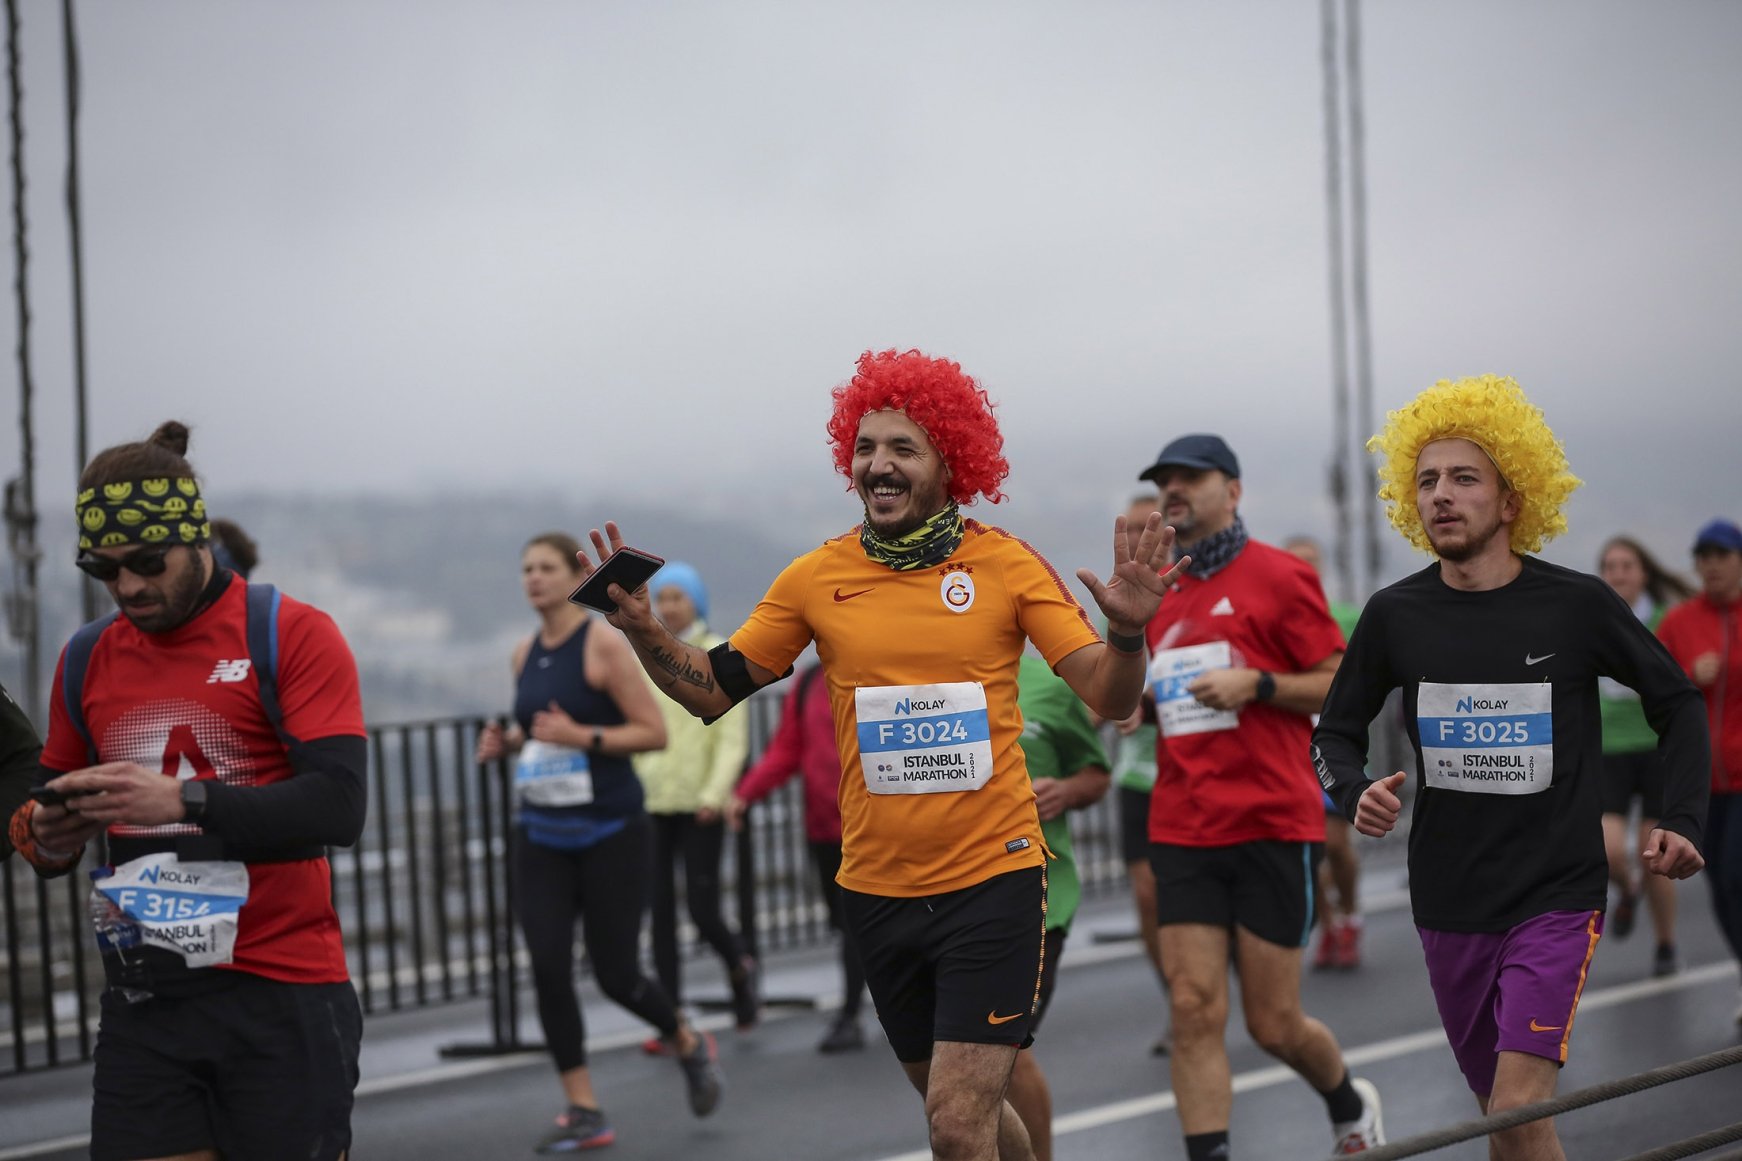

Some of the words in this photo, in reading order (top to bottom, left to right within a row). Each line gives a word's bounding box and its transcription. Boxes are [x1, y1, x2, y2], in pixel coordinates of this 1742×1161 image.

[878, 723, 894, 745] F
[901, 719, 968, 744] 3024
[1439, 720, 1455, 741] F
[1462, 721, 1529, 743] 3025
[903, 753, 965, 768] ISTANBUL
[1463, 754, 1525, 768] ISTANBUL
[903, 768, 967, 782] MARATHON
[1462, 769, 1526, 782] MARATHON
[119, 890, 138, 913] F
